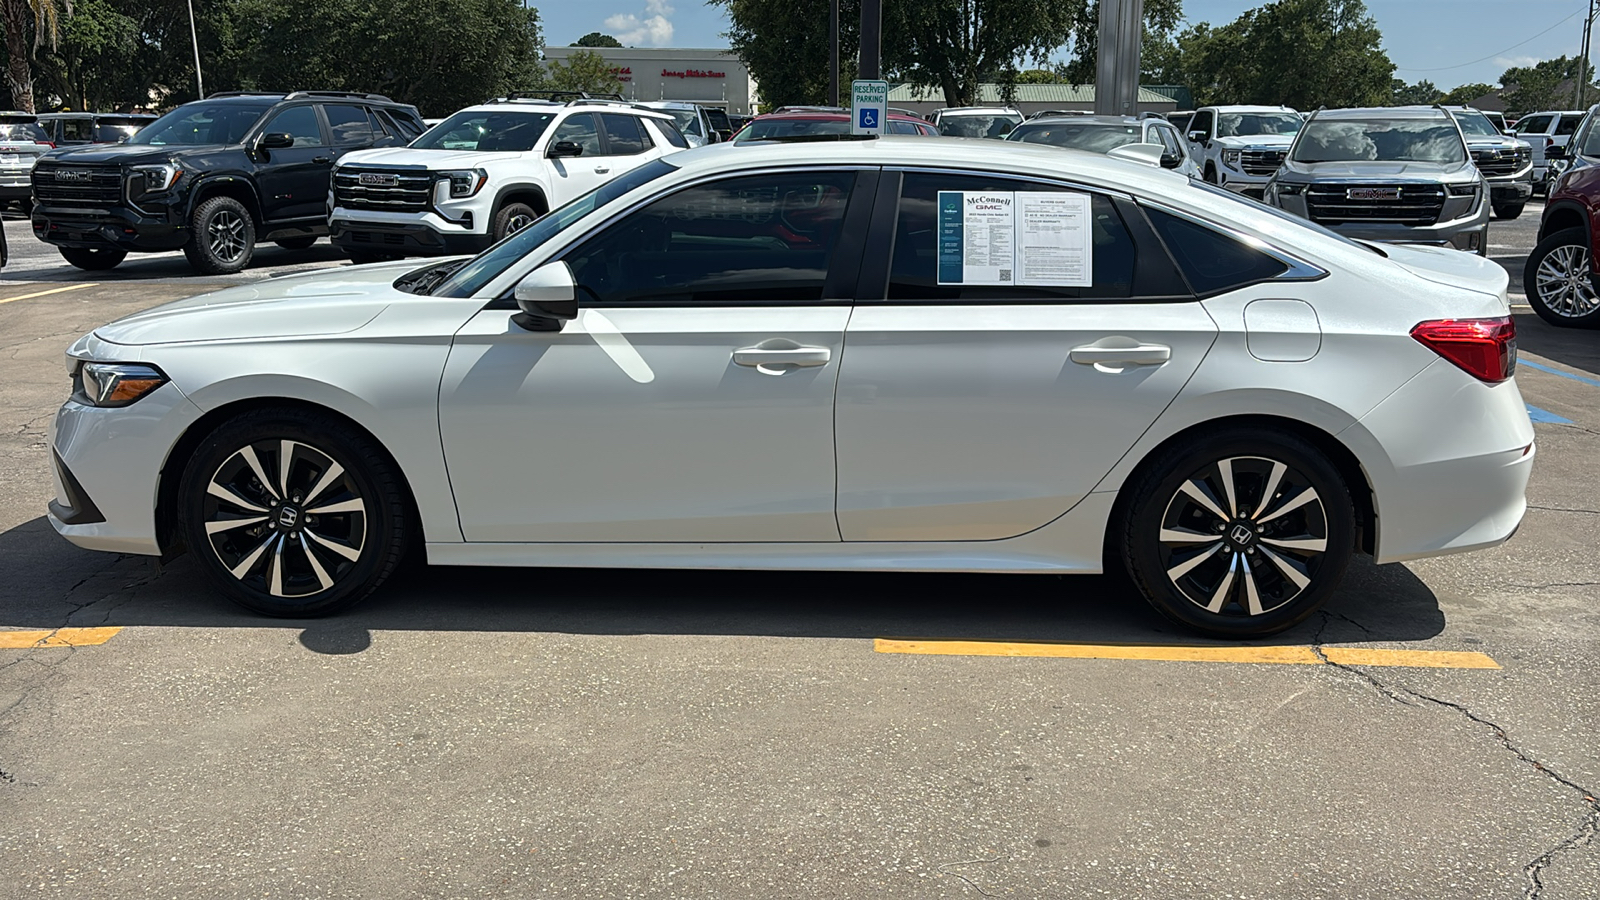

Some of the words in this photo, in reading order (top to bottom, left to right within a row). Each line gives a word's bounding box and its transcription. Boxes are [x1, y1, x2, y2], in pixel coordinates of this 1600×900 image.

[856, 95, 884, 103] PARKING
[1351, 188, 1399, 200] GMC
[966, 196, 1011, 206] McConnell
